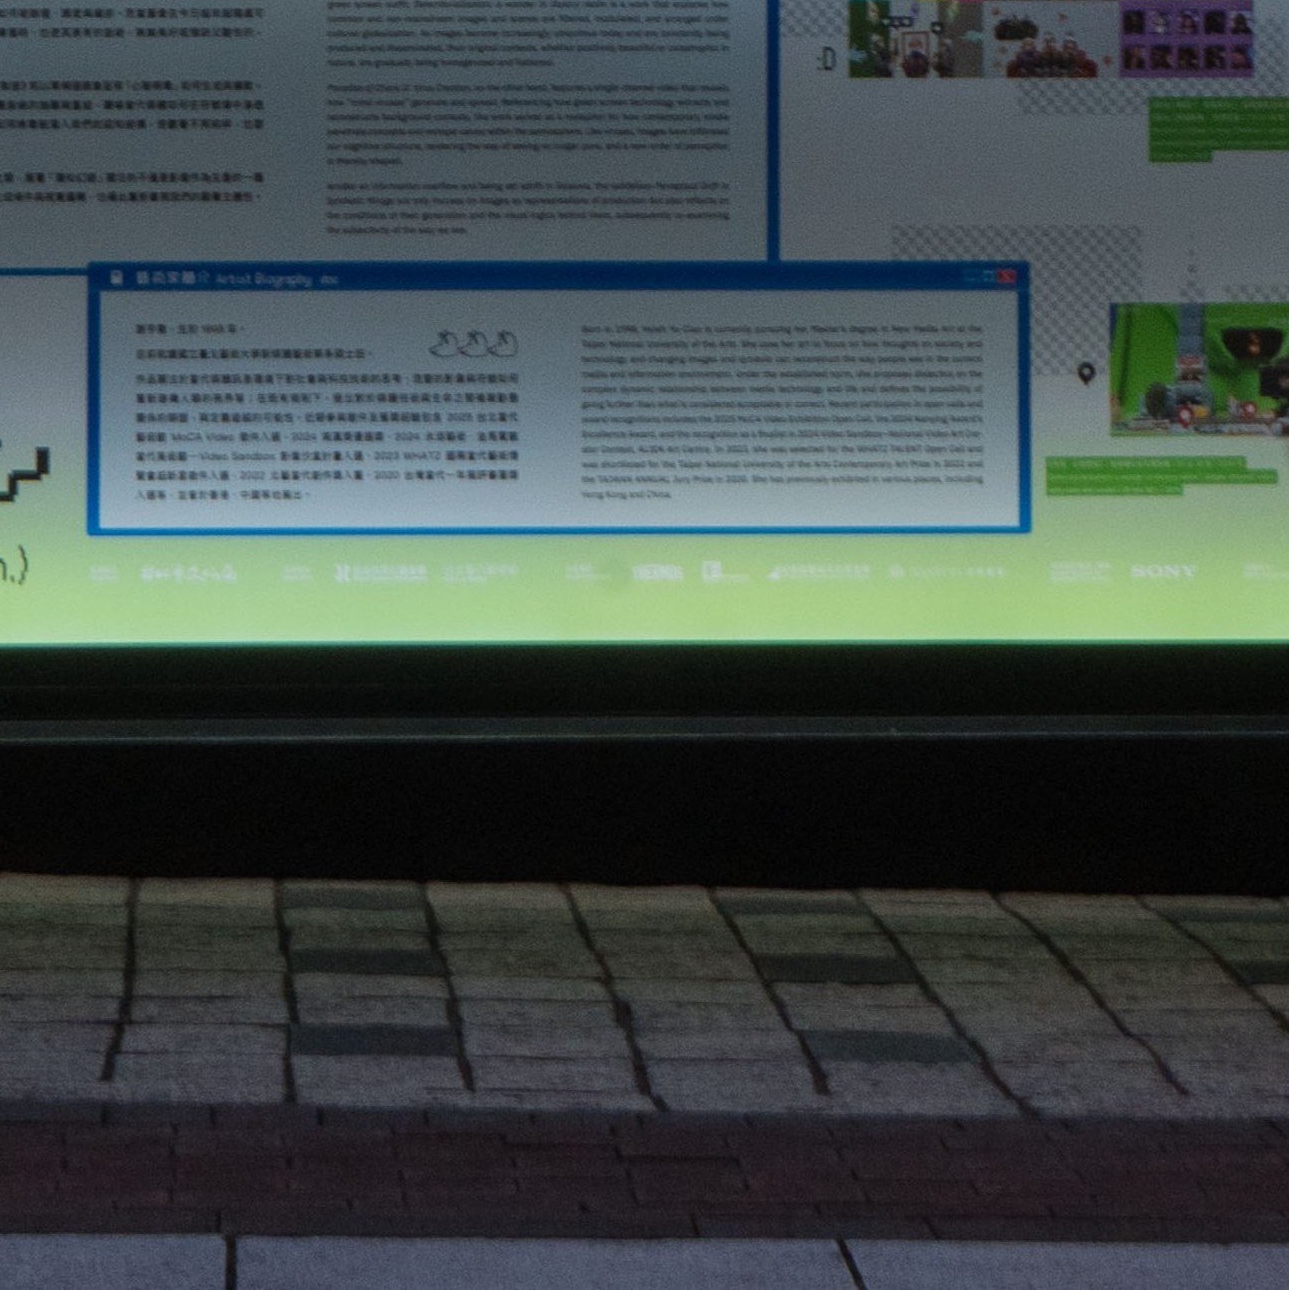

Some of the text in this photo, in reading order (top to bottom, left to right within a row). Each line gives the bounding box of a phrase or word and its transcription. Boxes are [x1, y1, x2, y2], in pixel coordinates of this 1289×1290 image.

[216, 273, 251, 285] Artist
[255, 272, 313, 288] Biography
[1130, 564, 1198, 580] SONY
